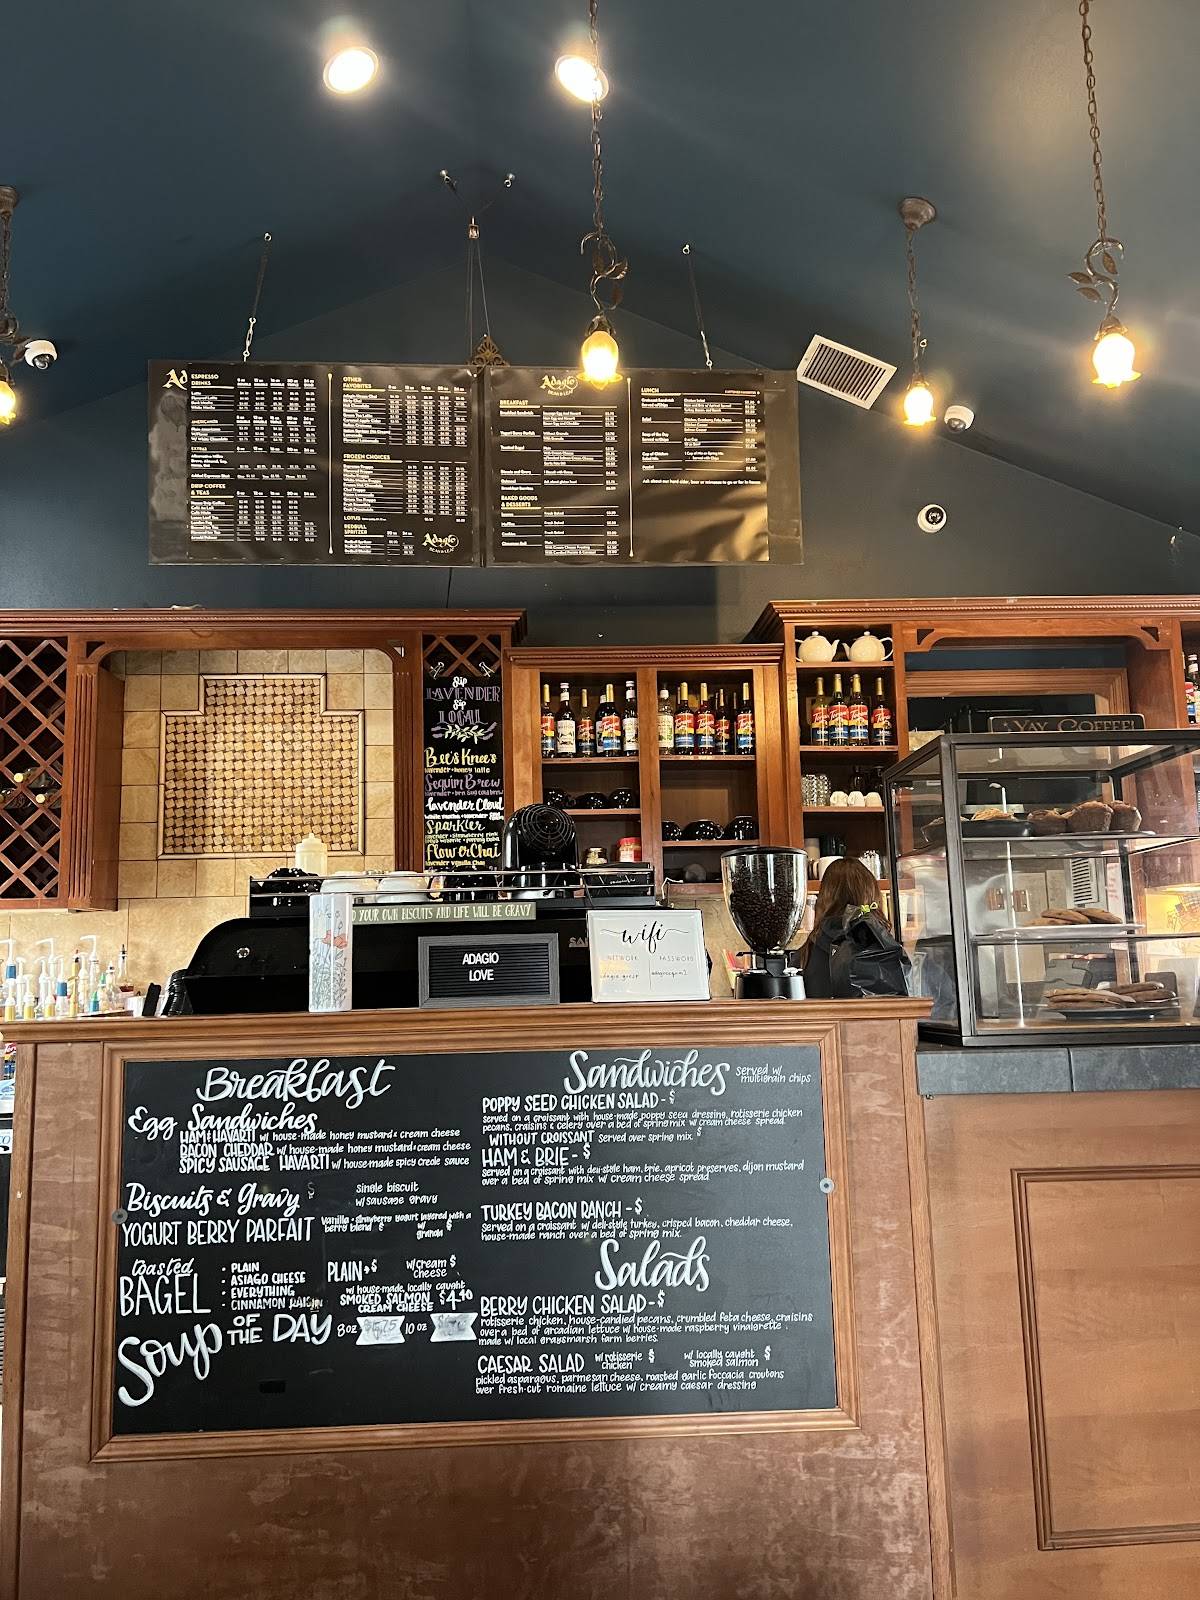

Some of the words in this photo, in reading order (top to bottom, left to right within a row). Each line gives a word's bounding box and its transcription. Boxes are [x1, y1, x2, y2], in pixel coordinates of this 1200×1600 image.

[426, 686, 500, 702] LAVENDER
[437, 709, 488, 726] LOCAL
[424, 746, 459, 768] Bee's
[464, 774, 500, 790] Brew
[476, 797, 504, 811] Cloud
[359, 908, 380, 922] YOUR
[382, 907, 398, 920] OWN
[402, 906, 433, 920] BISCUITS
[436, 906, 450, 919] AND
[454, 906, 469, 918] LIFE
[472, 905, 490, 918] WILL
[492, 904, 502, 917] BE
[505, 904, 532, 917] GRAVY
[608, 920, 680, 954] wifi
[462, 952, 499, 966] ADAGIO
[469, 969, 494, 982] LOVE
[564, 1049, 730, 1096] Sandwiches
[788, 1073, 812, 1084] chips
[196, 1058, 396, 1109] Breakfast
[482, 1096, 520, 1113] POPPY
[524, 1094, 558, 1112] SEED
[561, 1093, 615, 1110] CHICKEN
[618, 1092, 658, 1110] SALAD
[128, 1106, 178, 1140] Egg
[188, 1102, 318, 1134] Sandwiches
[482, 1113, 508, 1124] served
[533, 1112, 570, 1122] croissant
[772, 1108, 802, 1118] chicken
[557, 1120, 584, 1131] celery
[724, 1117, 752, 1126] cheese
[330, 1130, 354, 1140] honey
[400, 1130, 428, 1139] cream
[431, 1128, 460, 1138] cheese
[489, 1132, 538, 1146] WITHOUT
[540, 1130, 595, 1144] CROISSANT
[180, 1143, 218, 1159] BACON
[224, 1142, 274, 1158] CHEDDAR
[348, 1144, 372, 1154] honey
[442, 1141, 472, 1152] cheese
[482, 1147, 518, 1167] HAM
[520, 1148, 531, 1164] &
[535, 1146, 570, 1167] BRIE
[179, 1158, 216, 1174] SPICY
[218, 1156, 270, 1172] SAUSAGE
[280, 1154, 330, 1172] HAVARTI
[395, 1158, 416, 1168] spicy
[418, 1156, 442, 1166] creole
[444, 1156, 470, 1166] sauce
[482, 1168, 510, 1177] served
[664, 1162, 695, 1174] apricot
[742, 1161, 764, 1175] dijon
[766, 1160, 804, 1171] mustard
[610, 1174, 642, 1183] cream
[644, 1173, 675, 1182] cheese
[386, 1181, 420, 1192] biscuit
[126, 1182, 214, 1218] Biscuits
[216, 1188, 232, 1208] &
[480, 1202, 532, 1222] TURKEY
[536, 1200, 577, 1220] BACON
[580, 1200, 622, 1220] RANCH
[536, 1220, 577, 1230] croissant
[724, 1216, 760, 1227] cheddar
[122, 1220, 182, 1248] YOGURT
[187, 1218, 240, 1245] BERRY
[246, 1216, 315, 1243] PARFAIT
[539, 1230, 566, 1240] ranch
[569, 1231, 590, 1240] over
[132, 1258, 194, 1276] toasted
[231, 1262, 260, 1274] PLAIN
[327, 1260, 363, 1282] PLAIN
[594, 1236, 710, 1292] Salads
[231, 1274, 268, 1286] ASIAGO
[272, 1271, 306, 1284] CHEESE
[414, 1268, 448, 1278] cheese
[119, 1272, 212, 1316] BAGEL
[231, 1285, 296, 1298] EVERYTHING
[407, 1282, 432, 1292] locally
[231, 1298, 286, 1310] CINNAMON
[340, 1293, 382, 1306] SMOKED
[386, 1292, 431, 1305] SALMON
[480, 1295, 528, 1317] BERRY
[532, 1294, 595, 1316] CHICKEN
[600, 1294, 647, 1314] SALAD
[358, 1303, 392, 1314] CREAM
[396, 1301, 434, 1312] CHEESE
[232, 1313, 260, 1328] OF
[480, 1316, 525, 1327] rotisserie
[676, 1311, 716, 1323] crumbled
[720, 1312, 740, 1322] feta
[776, 1312, 814, 1322] craisins
[226, 1326, 263, 1346] THE
[272, 1313, 333, 1346] DAY
[512, 1326, 528, 1336] bed
[544, 1324, 585, 1335] arcadian
[588, 1324, 620, 1334] lettuce
[684, 1322, 730, 1334] raspberry
[478, 1336, 502, 1346] made
[516, 1336, 536, 1344] local
[601, 1334, 622, 1344] farm
[477, 1355, 533, 1374] CAESAR
[538, 1352, 584, 1373] SALAD
[689, 1358, 722, 1368] smoked
[726, 1358, 759, 1368] salmon
[696, 1350, 722, 1360] locally
[118, 1323, 222, 1408] Soup
[602, 1360, 632, 1370] chicken
[476, 1374, 506, 1386] pickled
[562, 1373, 608, 1384] parmesan
[646, 1370, 679, 1382] roasted
[748, 1368, 785, 1380] croutons
[498, 1384, 542, 1394] fresh-cut
[546, 1383, 587, 1394] romaine
[592, 1382, 622, 1392] lettuce
[640, 1380, 678, 1392] creamy
[680, 1381, 714, 1390] caesar
